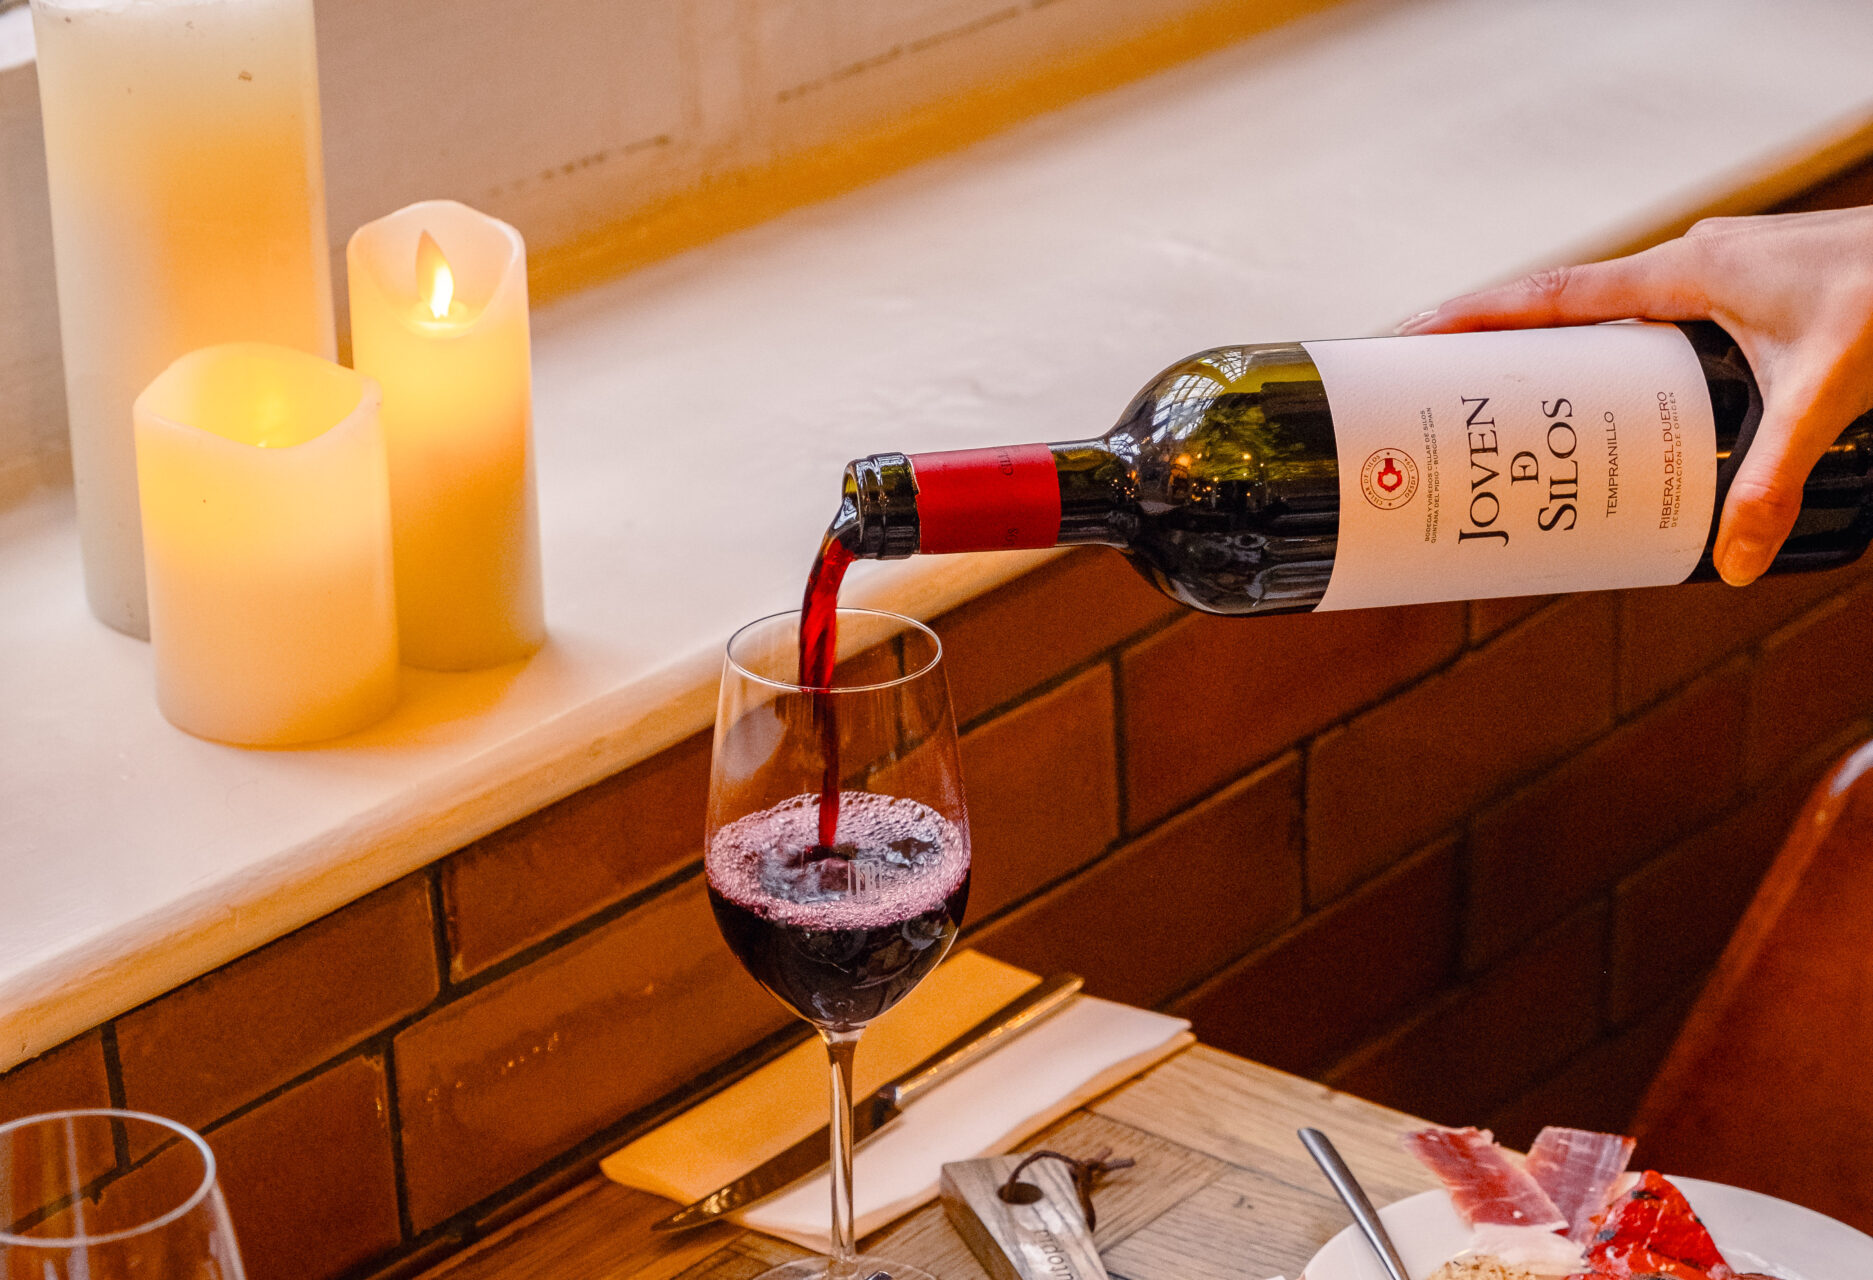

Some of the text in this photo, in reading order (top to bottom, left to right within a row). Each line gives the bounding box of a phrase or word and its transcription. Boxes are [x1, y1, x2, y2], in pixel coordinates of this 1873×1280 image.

[1420, 410, 1428, 431] SILOS
[1426, 407, 1434, 428] SPAIN
[1675, 433, 1682, 447] DE
[1458, 395, 1509, 547] JOVEN
[1537, 398, 1578, 532] SILOS
[1603, 411, 1619, 518] TEMPRANILLO
[1656, 391, 1675, 529] RIBERA DEL DUERO
[1431, 509, 1439, 544] QUINTANA
